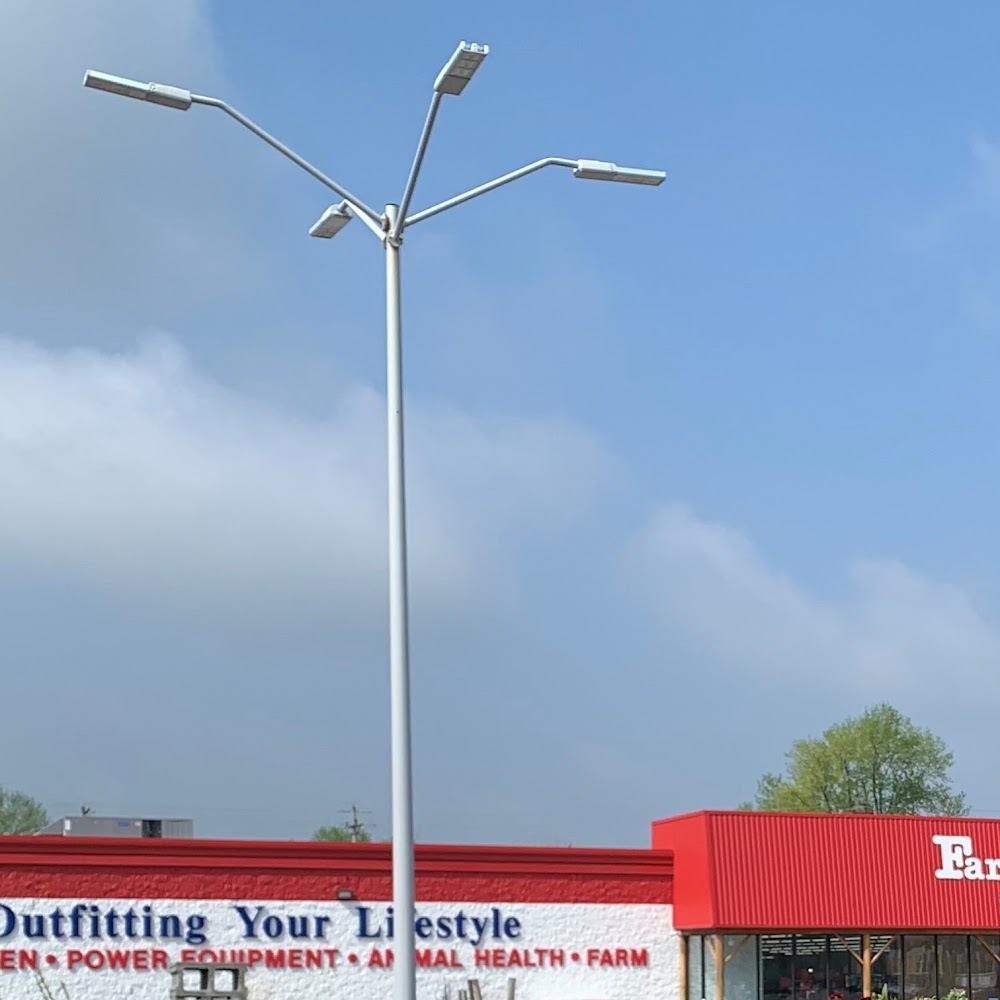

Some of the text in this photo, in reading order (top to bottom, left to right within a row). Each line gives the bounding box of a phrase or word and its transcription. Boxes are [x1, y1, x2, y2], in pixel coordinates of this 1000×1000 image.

[234, 905, 330, 939] Your
[356, 906, 522, 945] Liestyle
[67, 949, 168, 970] POWER
[368, 949, 462, 967] AMAL
[474, 949, 564, 967] HEALTH
[587, 949, 648, 967] FARM
